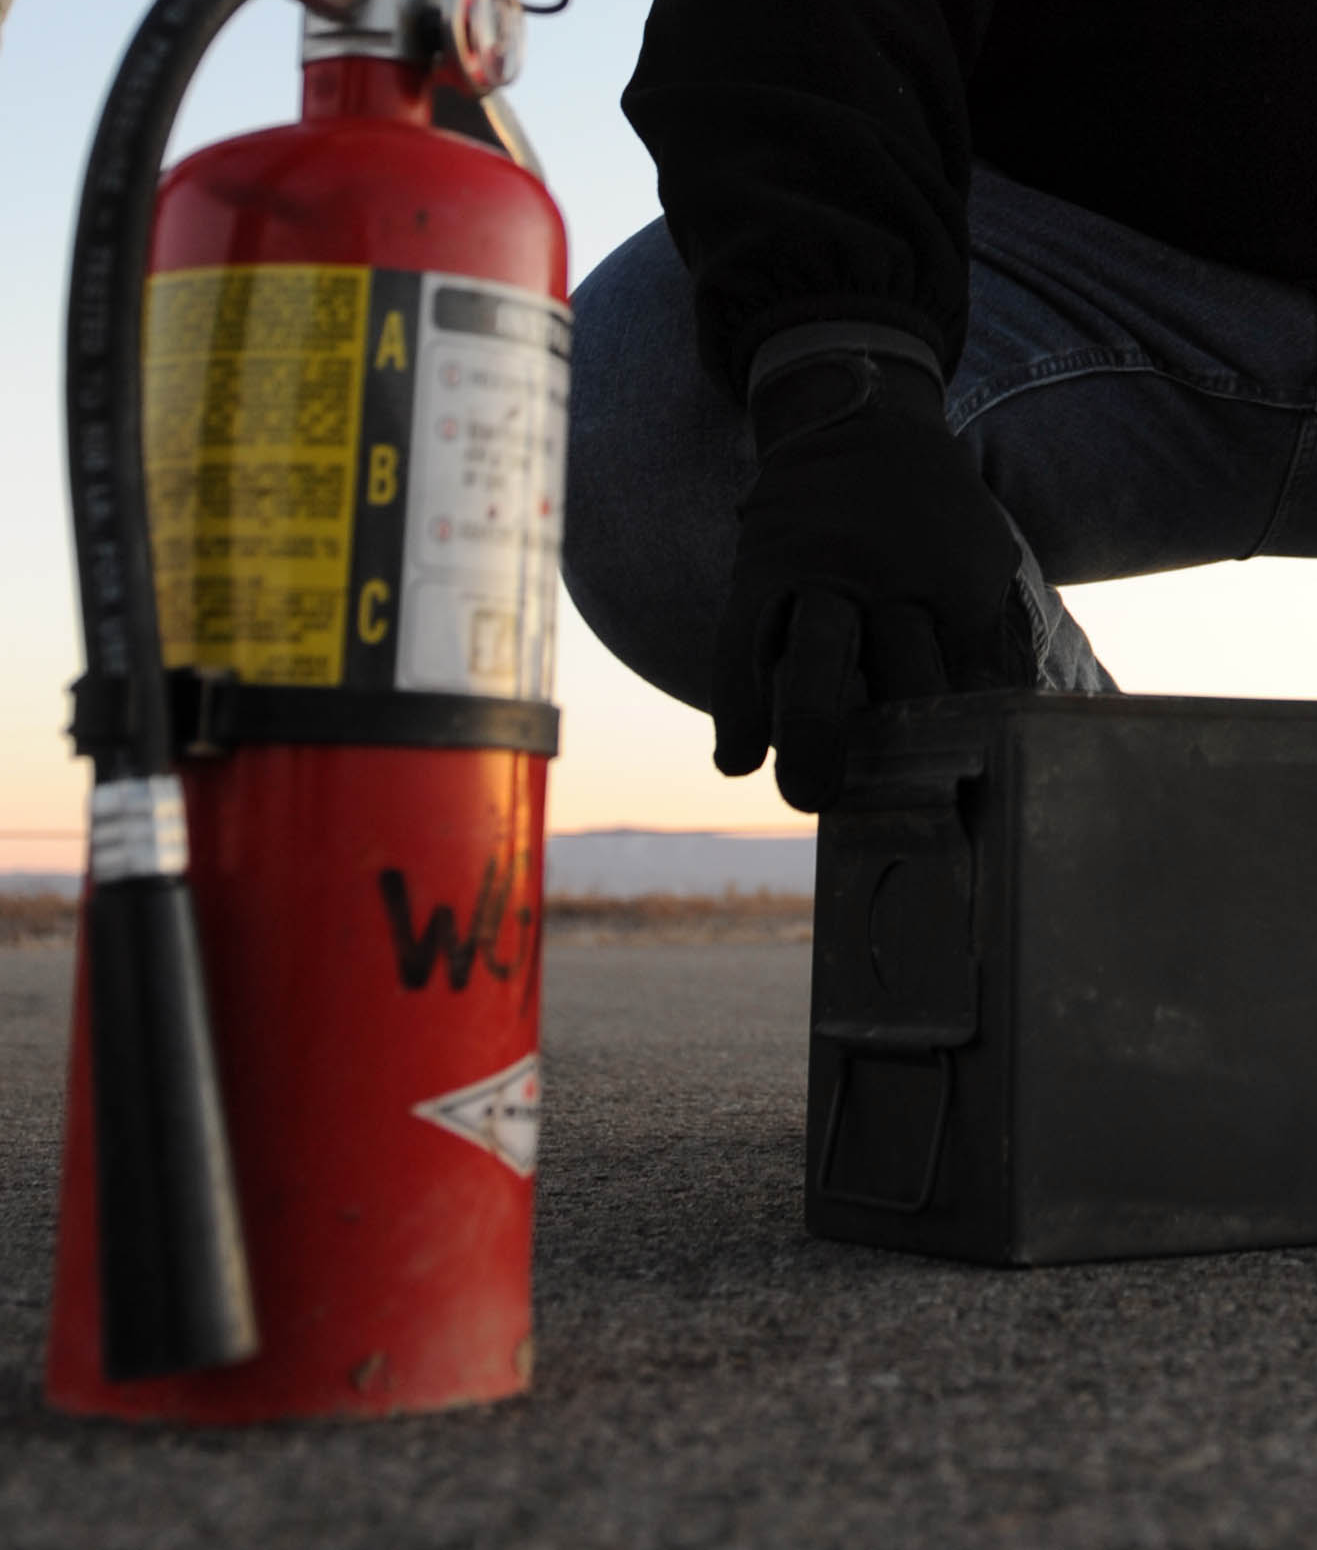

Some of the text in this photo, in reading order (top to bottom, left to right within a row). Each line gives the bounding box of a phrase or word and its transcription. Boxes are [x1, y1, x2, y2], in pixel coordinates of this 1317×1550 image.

[375, 310, 408, 371] A
[366, 446, 398, 505] B
[357, 578, 390, 645] C
